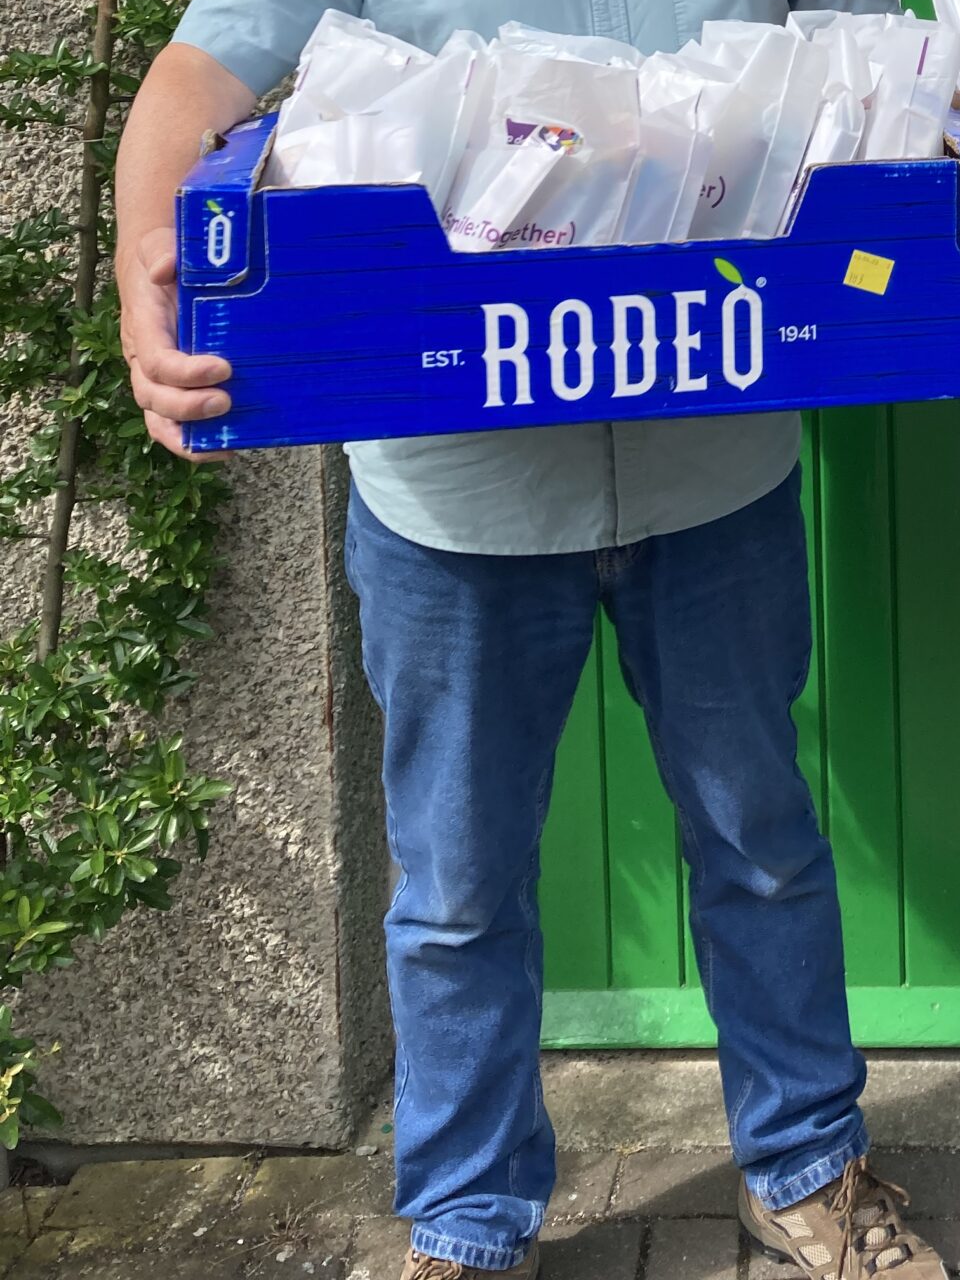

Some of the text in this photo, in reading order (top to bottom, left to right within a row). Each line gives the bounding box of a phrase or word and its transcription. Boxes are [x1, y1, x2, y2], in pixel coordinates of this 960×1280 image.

[422, 284, 817, 408] EST. RODEO 1941
